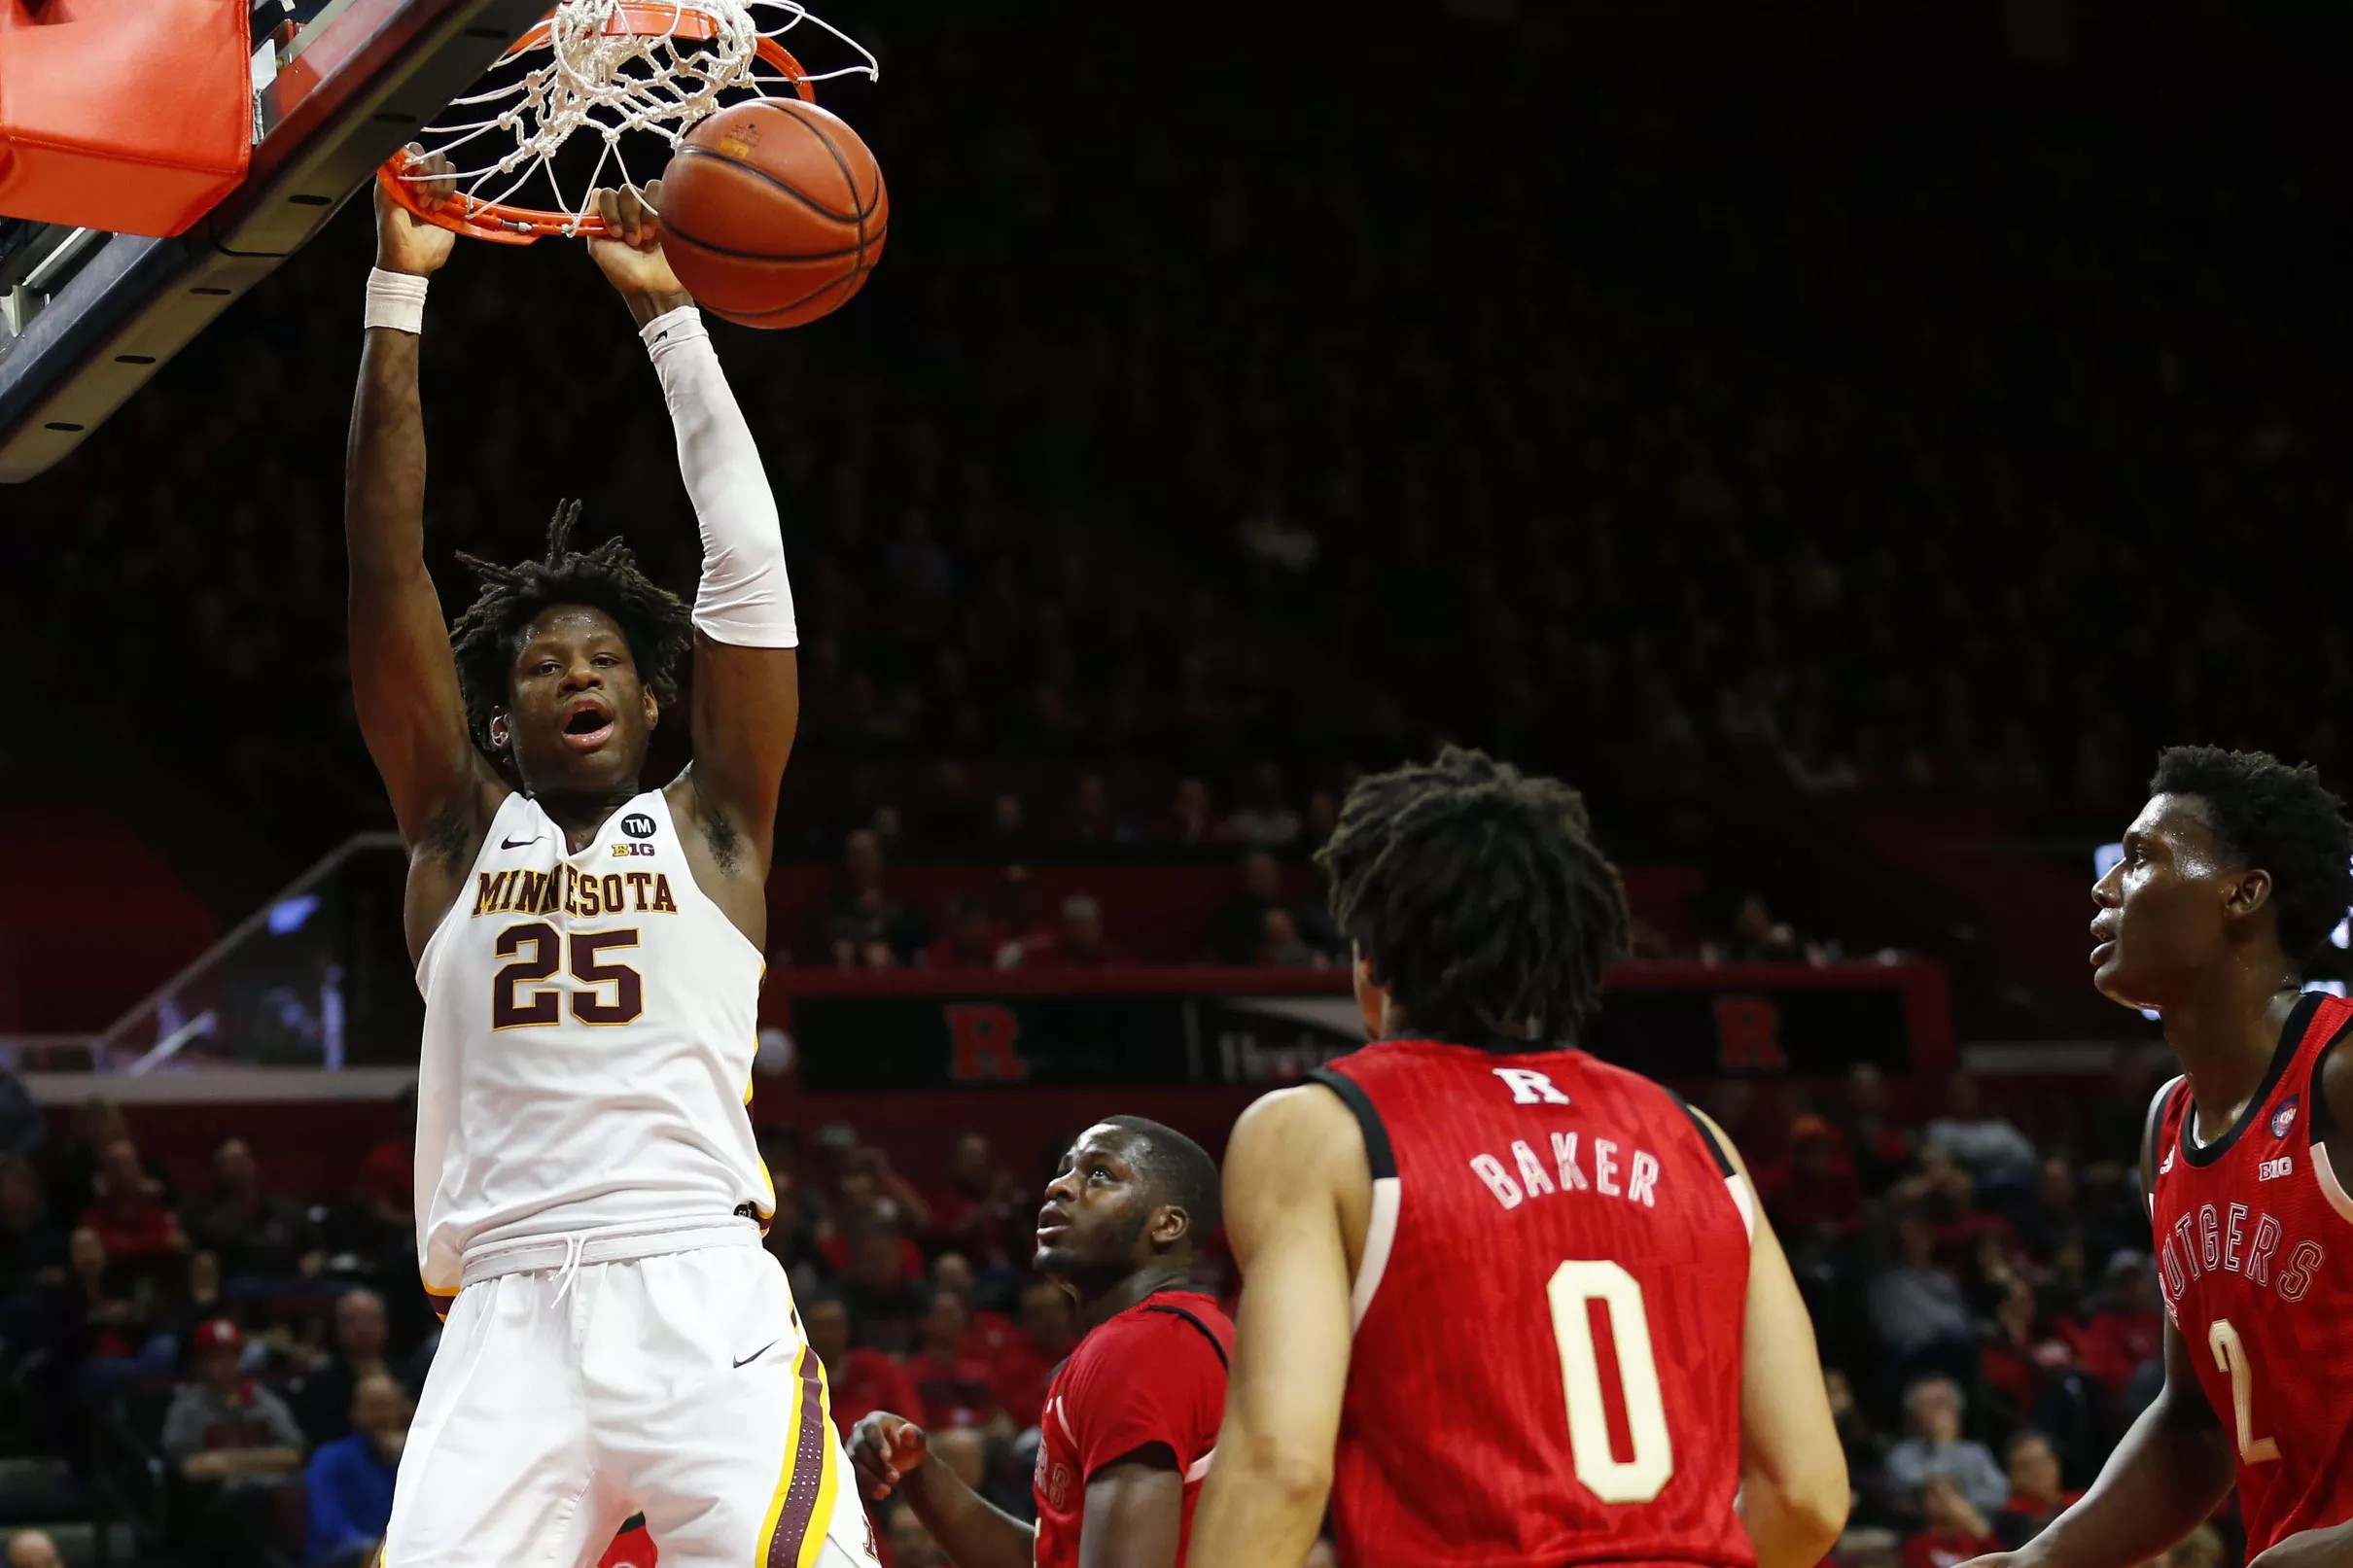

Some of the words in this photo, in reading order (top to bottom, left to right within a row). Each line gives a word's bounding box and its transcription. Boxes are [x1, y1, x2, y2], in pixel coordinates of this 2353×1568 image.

[625, 819, 651, 833] TM
[471, 862, 678, 919] MINNESOTA
[491, 920, 644, 1032] 25
[943, 1003, 1027, 1079] R
[1713, 996, 1787, 1068] R
[1492, 1067, 1570, 1104] R
[1469, 1132, 1659, 1210] BAKER
[1546, 1260, 1673, 1504] 0
[2208, 1318, 2282, 1465] 2
